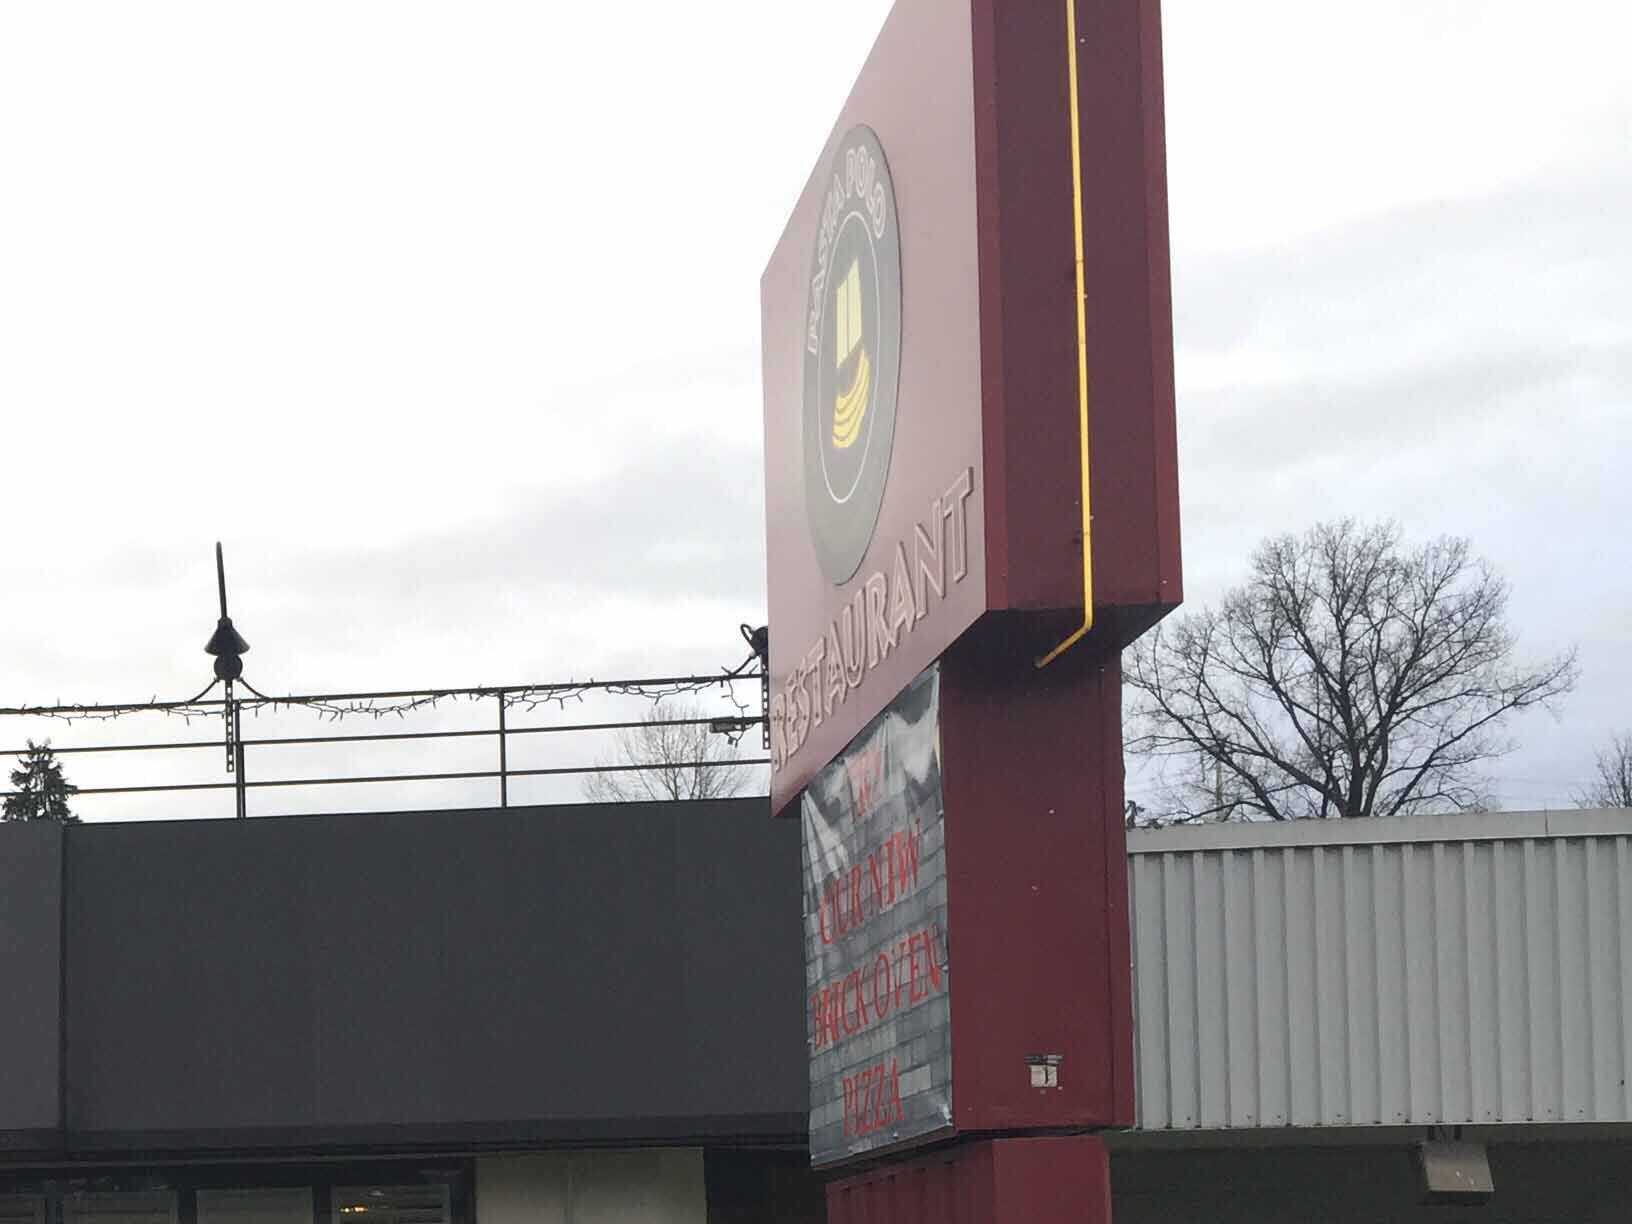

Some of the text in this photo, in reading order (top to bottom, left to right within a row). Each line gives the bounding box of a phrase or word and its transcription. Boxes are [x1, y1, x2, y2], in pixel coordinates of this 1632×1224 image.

[773, 465, 974, 774] RESTAURANT
[873, 923, 942, 1019] OVEN
[841, 1055, 904, 1137] PIZZA
